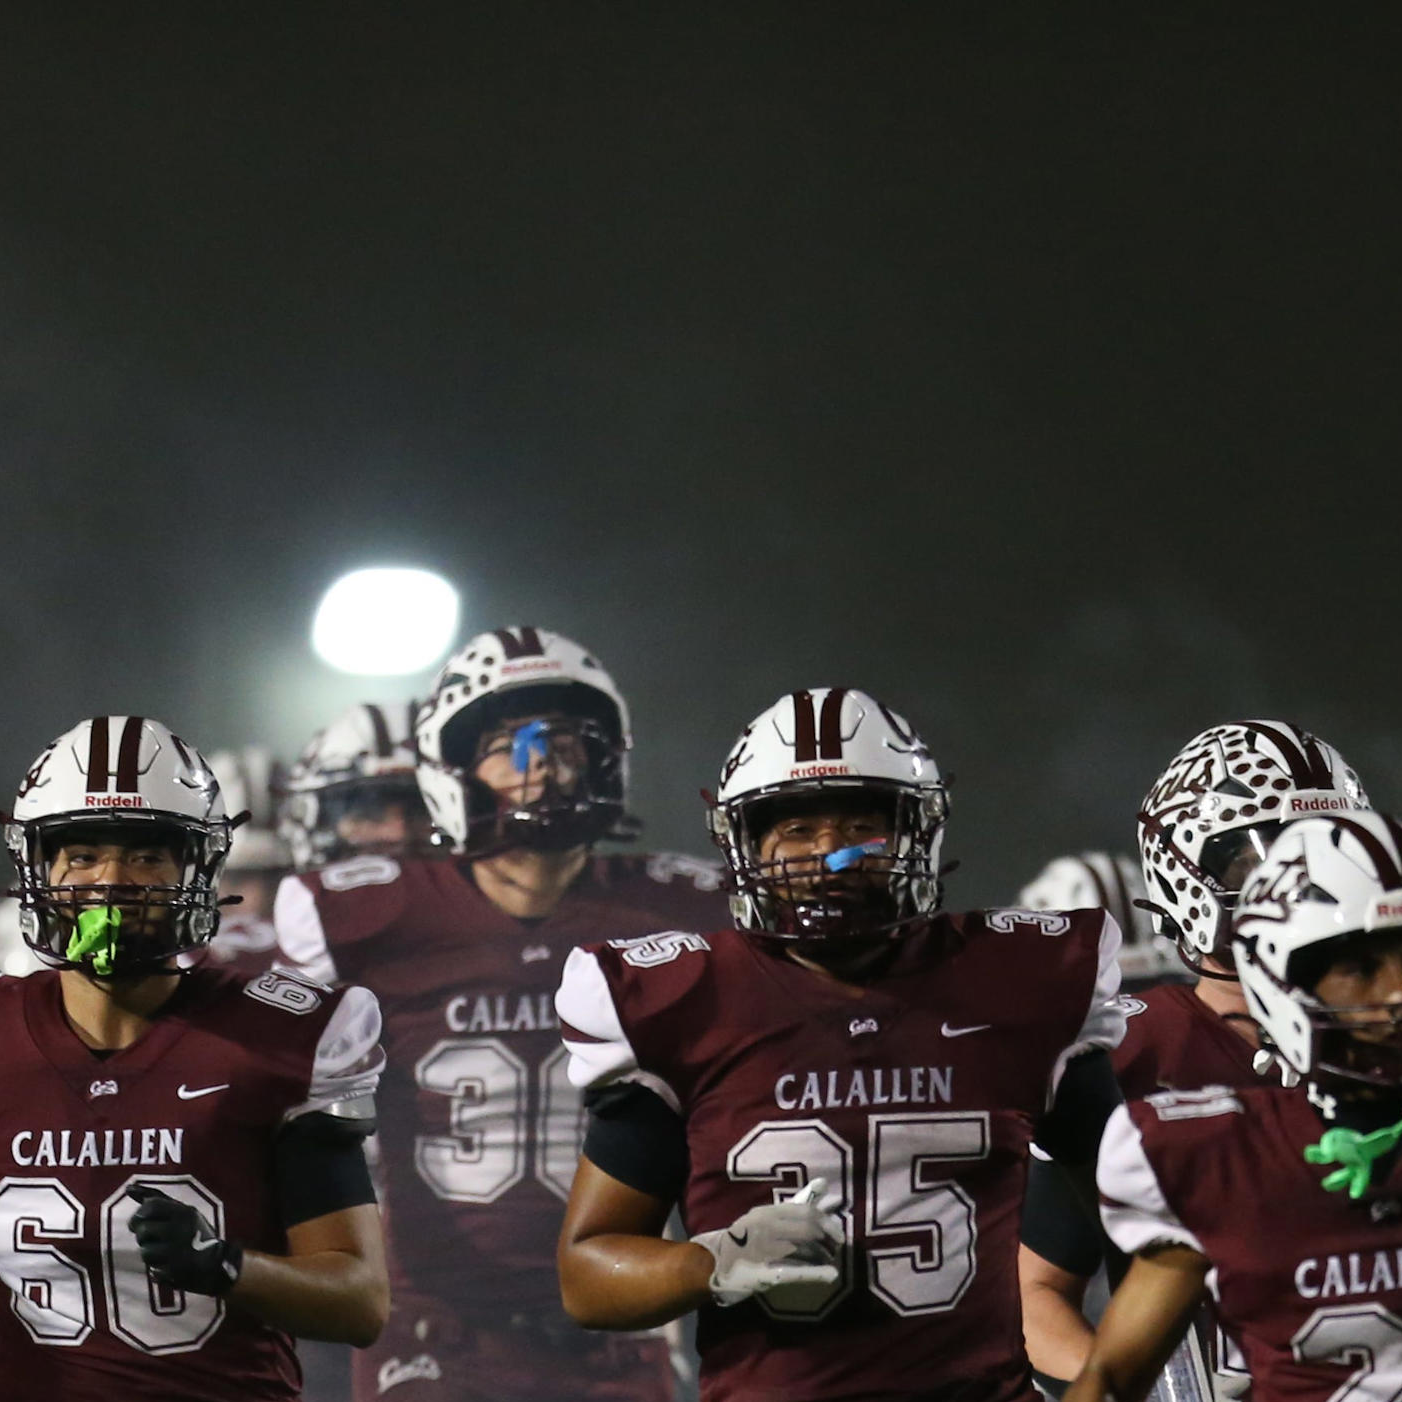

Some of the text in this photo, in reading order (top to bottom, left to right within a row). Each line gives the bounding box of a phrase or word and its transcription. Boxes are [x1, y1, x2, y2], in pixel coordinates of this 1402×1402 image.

[85, 795, 143, 808] Riddell
[1290, 796, 1349, 812] Riddell
[446, 994, 561, 1033] CALAL
[774, 1066, 954, 1111] CALALLEN
[11, 1128, 184, 1167] CALALLEN
[726, 1110, 991, 1322] 35
